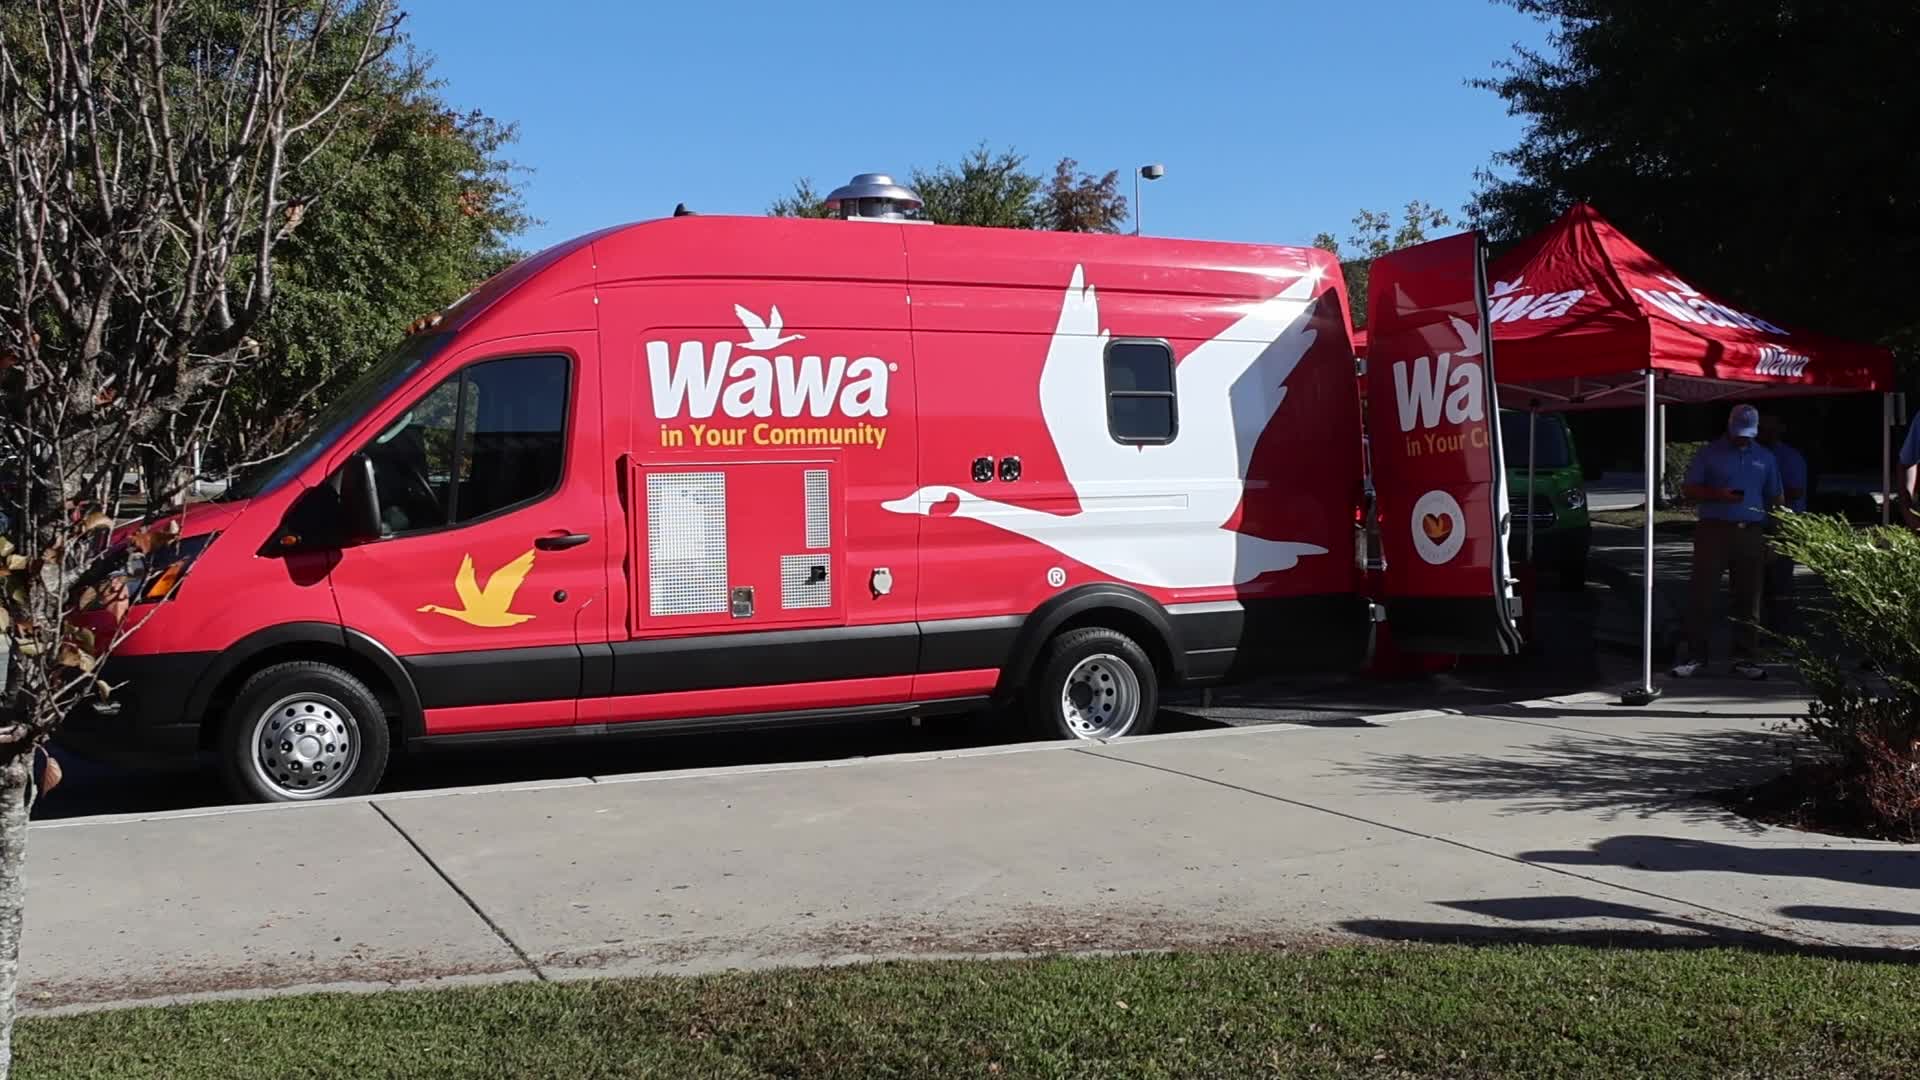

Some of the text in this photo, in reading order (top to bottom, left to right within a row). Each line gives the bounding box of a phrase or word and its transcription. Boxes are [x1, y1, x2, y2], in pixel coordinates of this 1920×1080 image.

[1755, 347, 1809, 377] Wawa
[660, 422, 887, 449] in Your Community
[1406, 436, 1421, 457] in
[1424, 433, 1465, 455] Your
